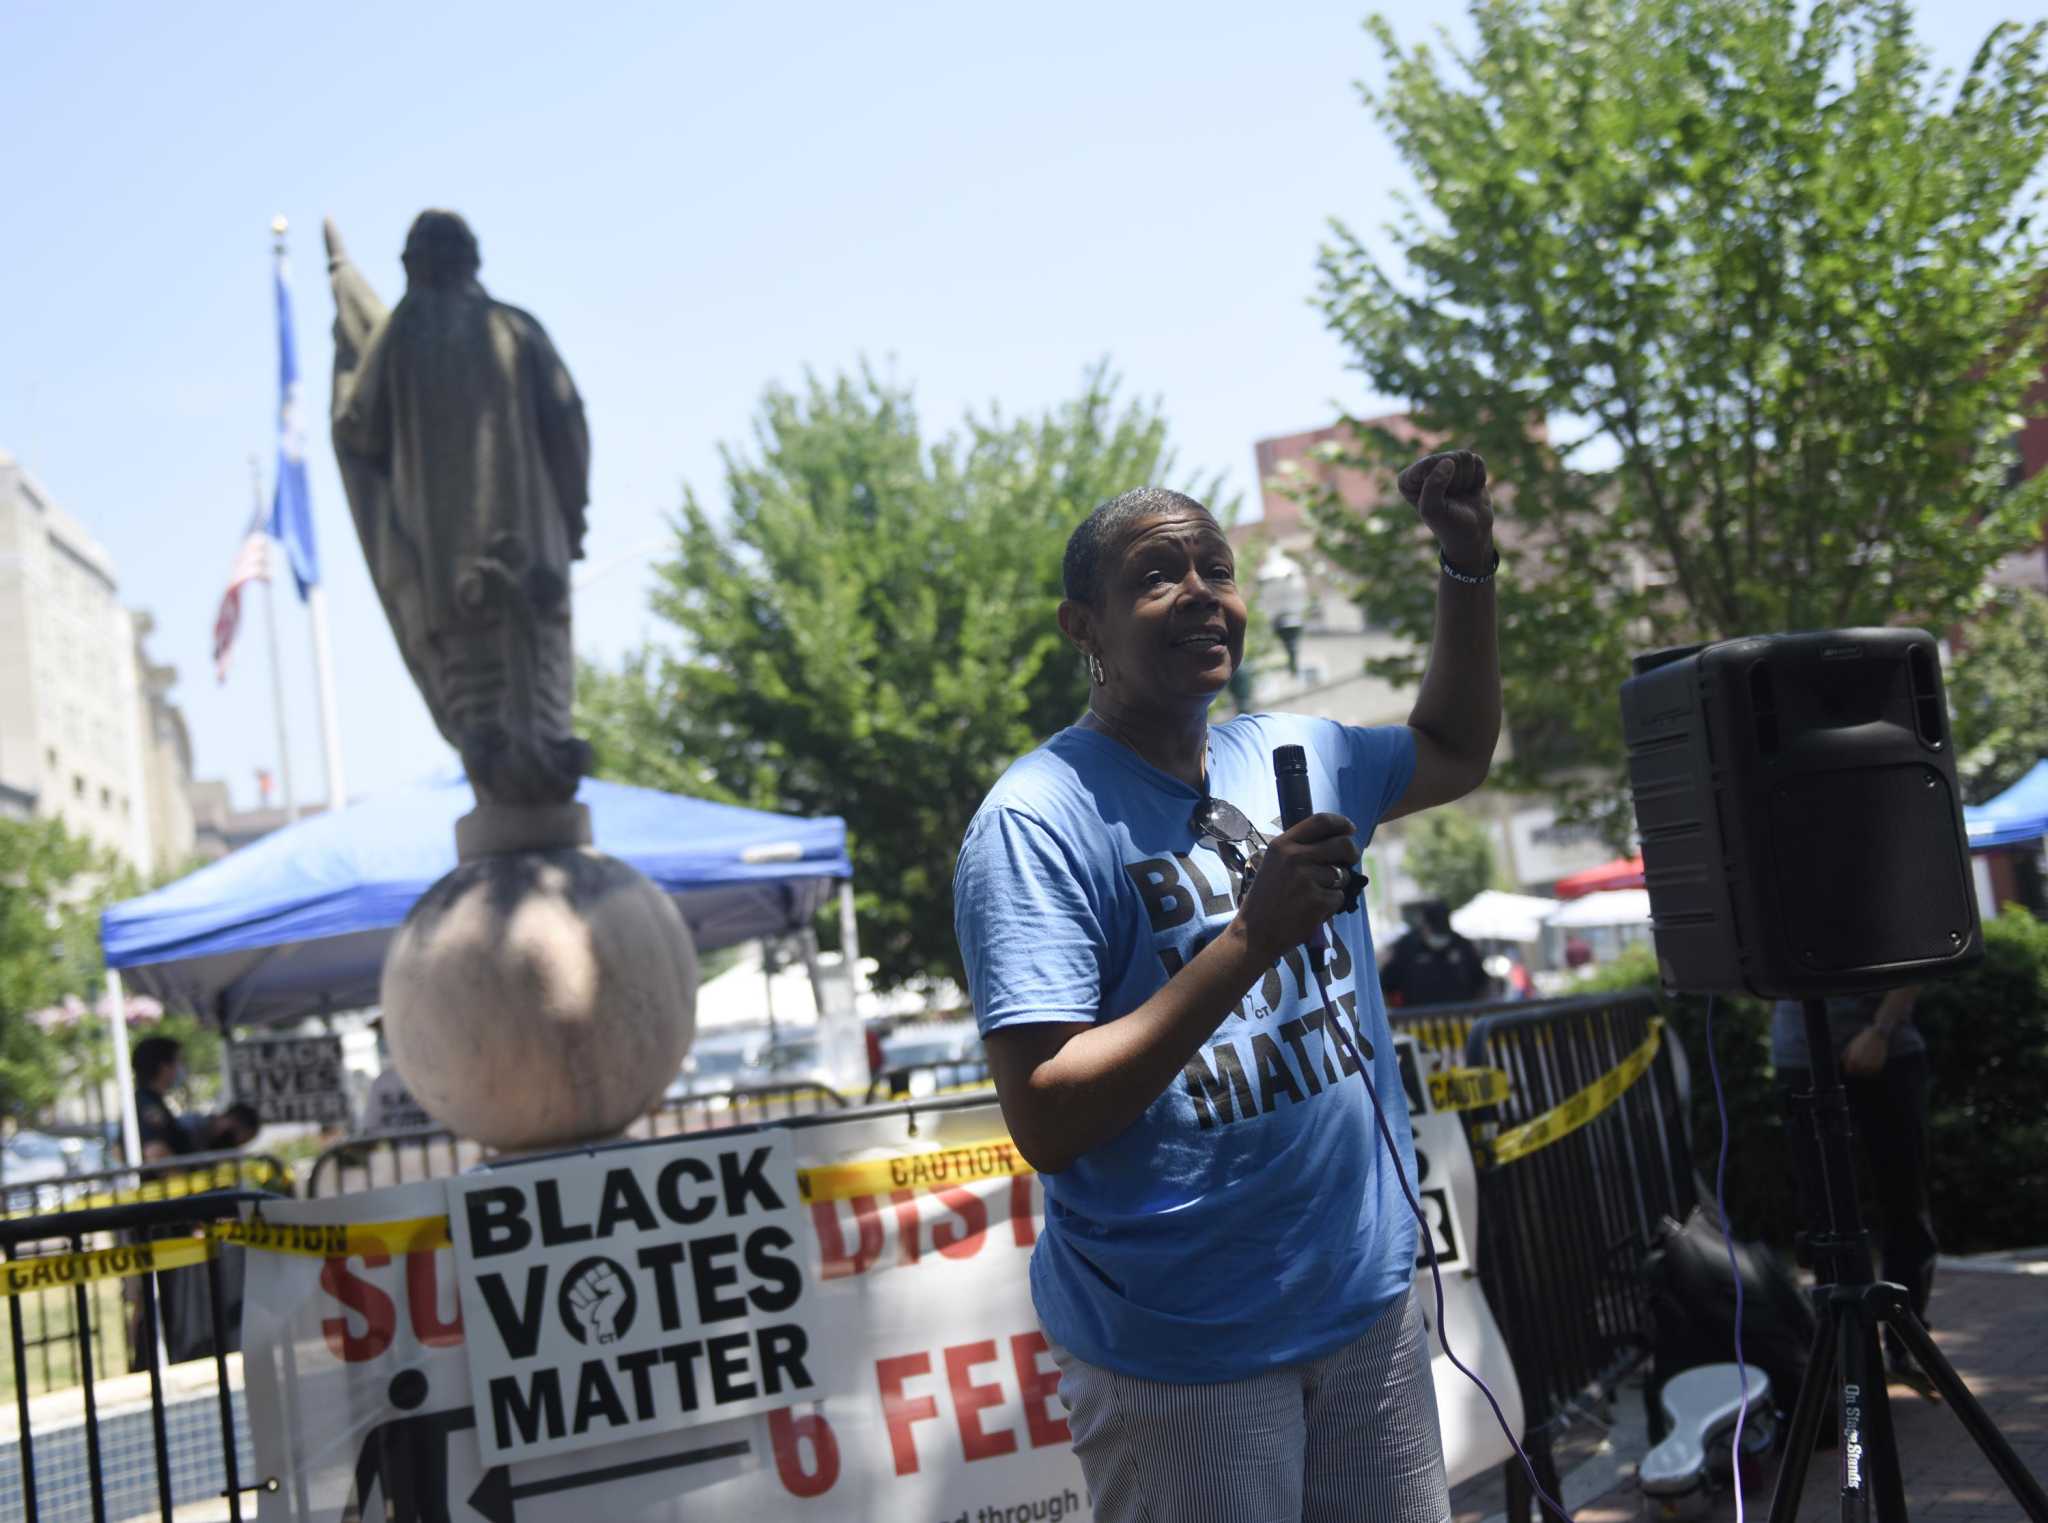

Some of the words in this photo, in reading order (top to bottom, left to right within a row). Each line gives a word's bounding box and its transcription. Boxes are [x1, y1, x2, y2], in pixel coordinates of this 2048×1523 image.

[1444, 564, 1477, 584] BLACK
[890, 1143, 1016, 1187] CAUTION
[464, 1146, 786, 1259] BLACK
[7, 1247, 155, 1291] CAUTION
[489, 1323, 814, 1451] MATTER
[1846, 1443, 1863, 1489] Stands
[978, 1488, 1080, 1523] through
